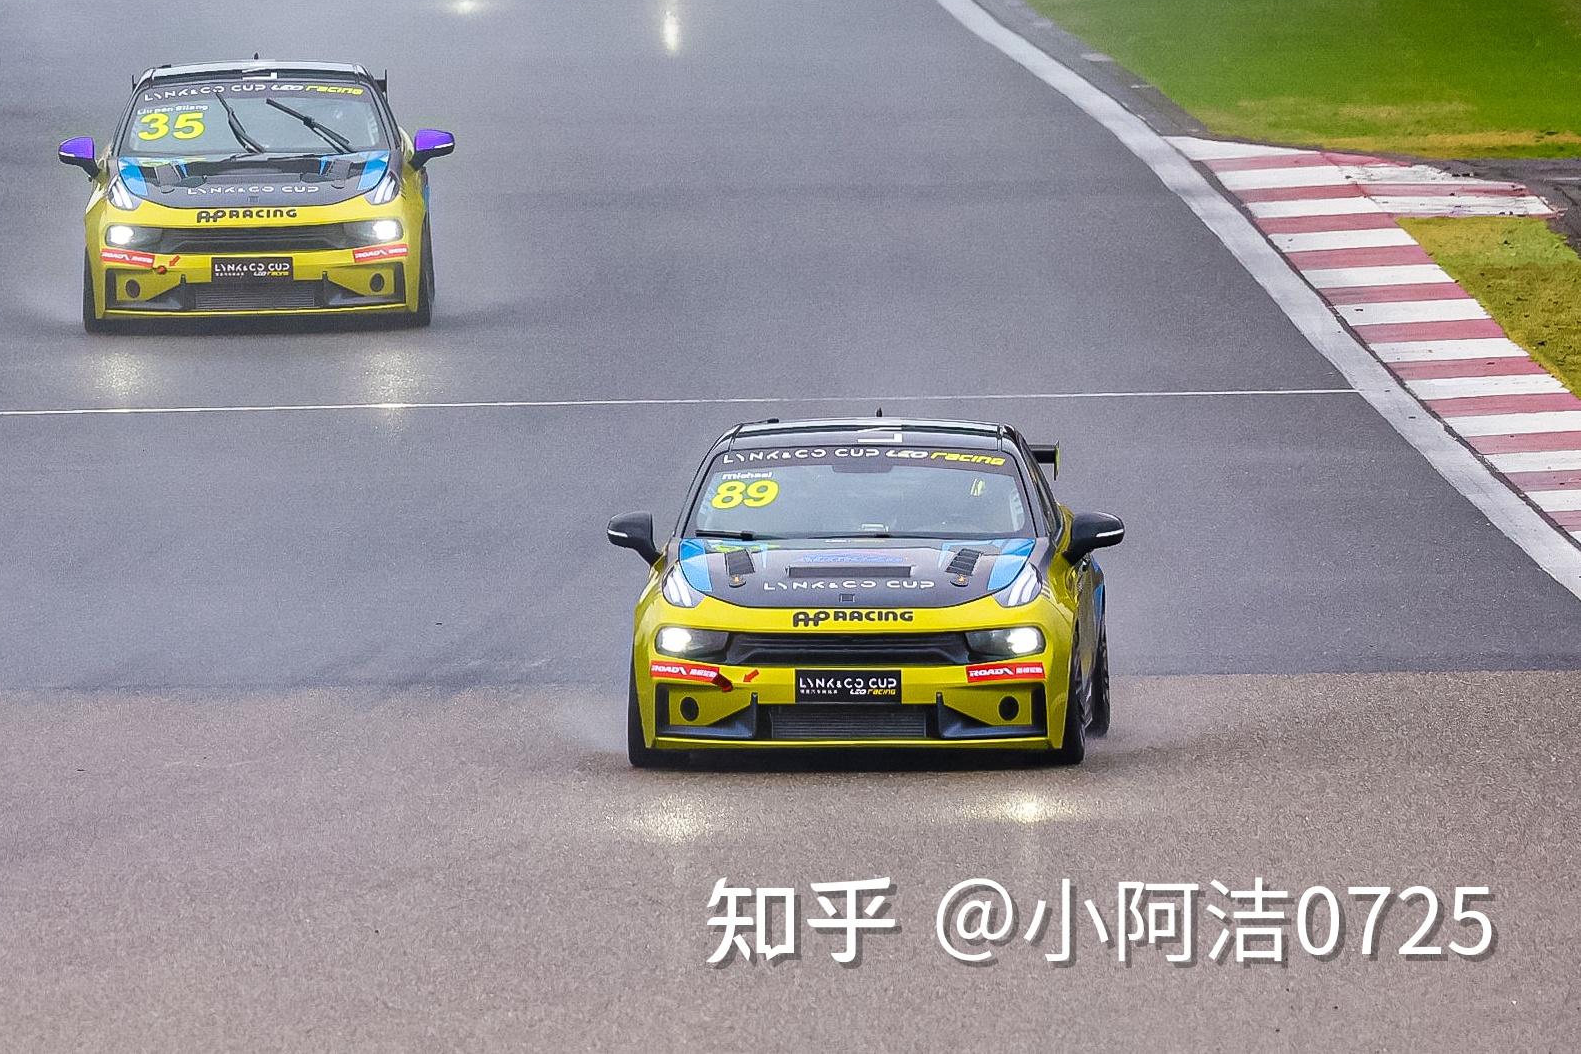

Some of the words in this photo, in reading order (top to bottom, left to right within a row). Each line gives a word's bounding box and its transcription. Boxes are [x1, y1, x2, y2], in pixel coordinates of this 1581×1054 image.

[231, 84, 266, 92] CUP
[138, 111, 206, 141] 35
[281, 186, 320, 194] CUP
[229, 209, 297, 219] RACING
[268, 263, 290, 271] CUP
[834, 448, 880, 457] CUP
[930, 451, 1006, 466] racing
[711, 480, 779, 509] 89
[886, 580, 935, 589] CUP
[833, 610, 914, 622] RACING
[799, 677, 864, 688] LYNK&CO
[868, 677, 897, 688] CUP
